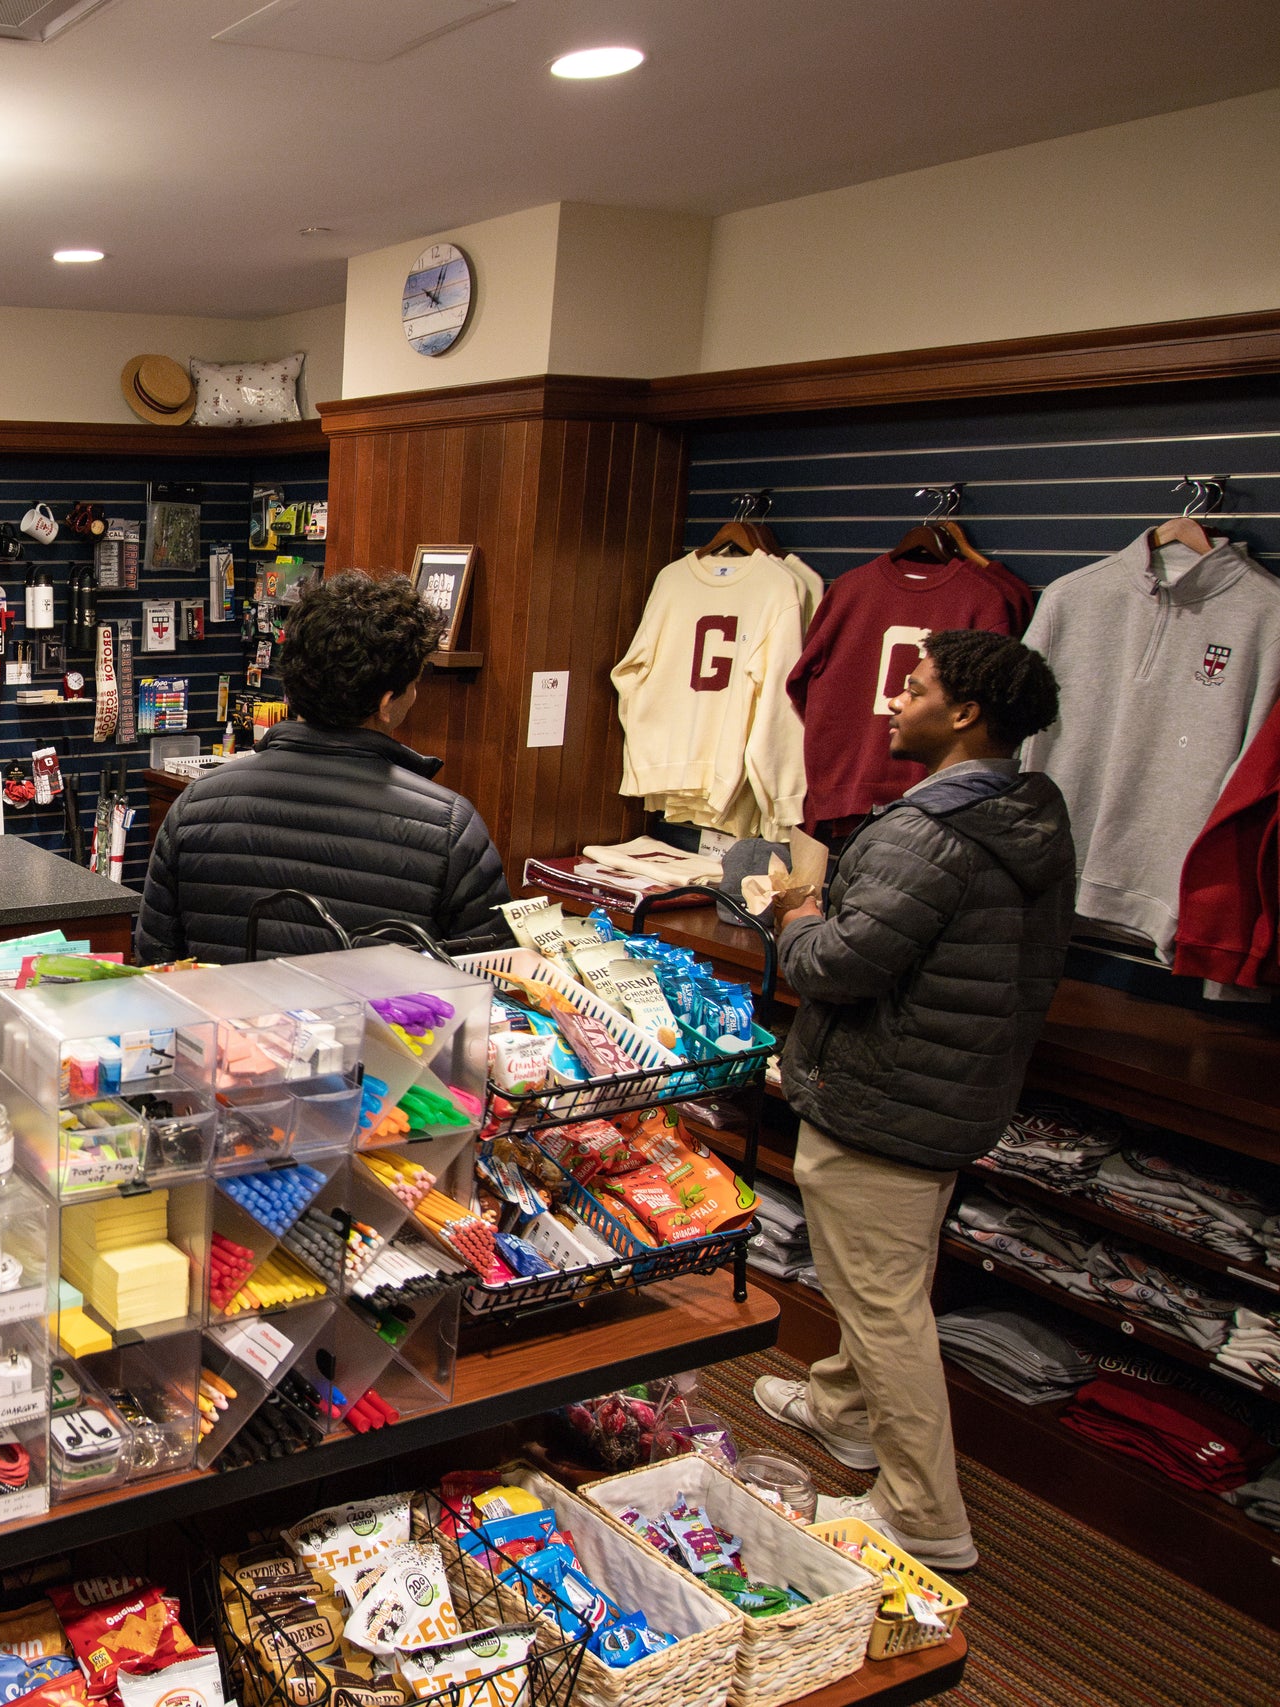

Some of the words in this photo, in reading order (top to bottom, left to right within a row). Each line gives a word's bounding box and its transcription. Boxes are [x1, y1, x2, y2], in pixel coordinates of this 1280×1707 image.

[431, 245, 441, 259] 12
[407, 277, 417, 289] 10
[403, 300, 410, 316] 9
[407, 324, 413, 337] 8
[106, 530, 121, 538] ECAL
[690, 615, 738, 692] G
[122, 652, 132, 696] GROTON
[123, 700, 135, 741] SCHOOL
[44, 757, 54, 766] G
[510, 899, 550, 920] BIENA
[534, 929, 564, 947] BIEN
[586, 967, 610, 982] BIE
[615, 976, 659, 994] BIENA
[634, 995, 665, 1005] SNACKS
[1, 1402, 39, 1417] CHARGER
[351, 1518, 376, 1528] PROTEIN
[408, 1577, 426, 1596] 20G
[414, 1584, 431, 1602] PROTEIN
[267, 1623, 327, 1653] SNDER'S
[472, 1639, 498, 1649] PROTEIN
[618, 1625, 629, 1651] OREO
